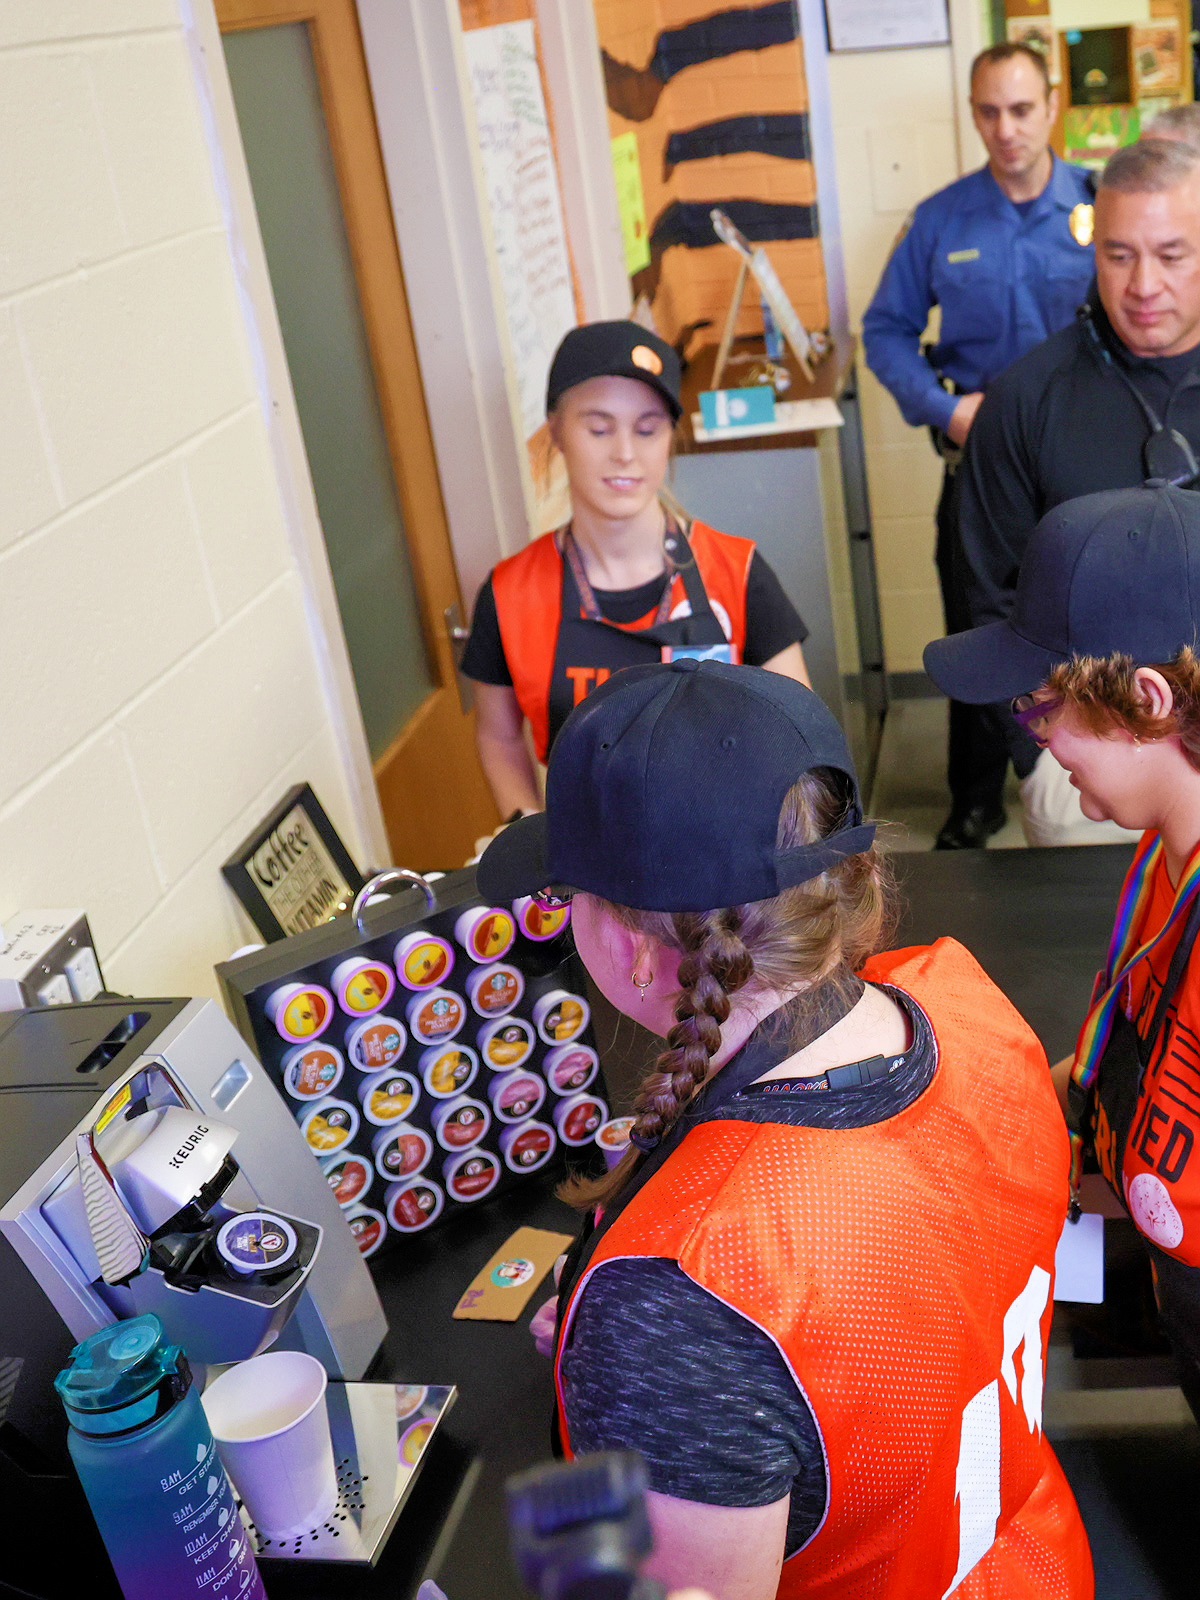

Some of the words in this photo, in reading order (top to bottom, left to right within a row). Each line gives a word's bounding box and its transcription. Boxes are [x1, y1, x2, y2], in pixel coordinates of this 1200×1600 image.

[252, 822, 309, 888] Coffee
[168, 1124, 210, 1170] KEURIG
[160, 1469, 183, 1491] 8AM
[178, 1474, 198, 1496] GET
[182, 1497, 220, 1534] REMEMBER
[184, 1532, 208, 1556] 10AM
[193, 1541, 219, 1565] KEEP
[212, 1566, 239, 1592] DON'T
